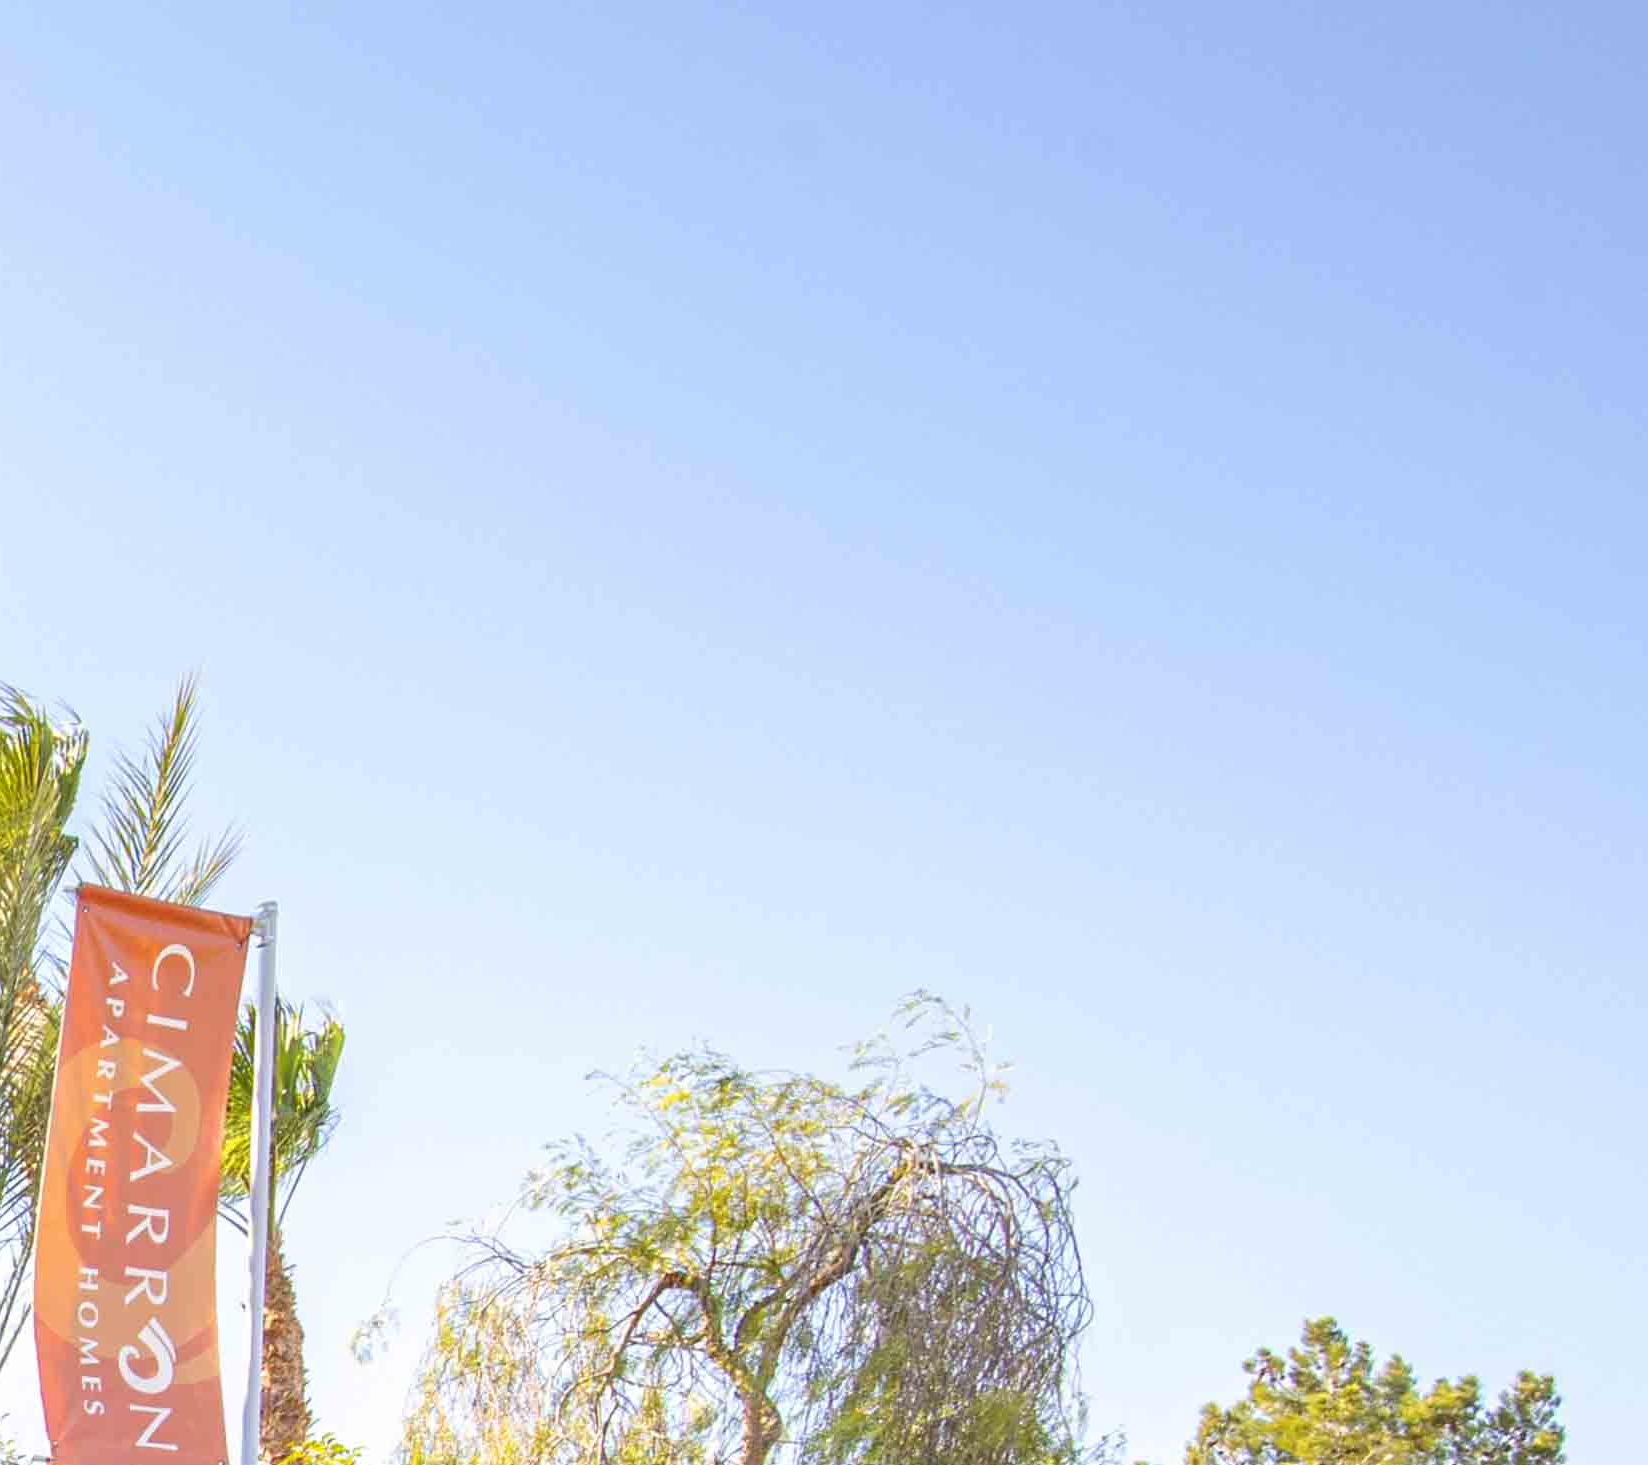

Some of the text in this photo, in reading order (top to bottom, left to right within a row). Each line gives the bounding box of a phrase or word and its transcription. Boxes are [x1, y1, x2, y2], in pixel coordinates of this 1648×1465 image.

[76, 959, 131, 1417] APARTMENT HOMES
[116, 942, 196, 1453] CIMARRON
